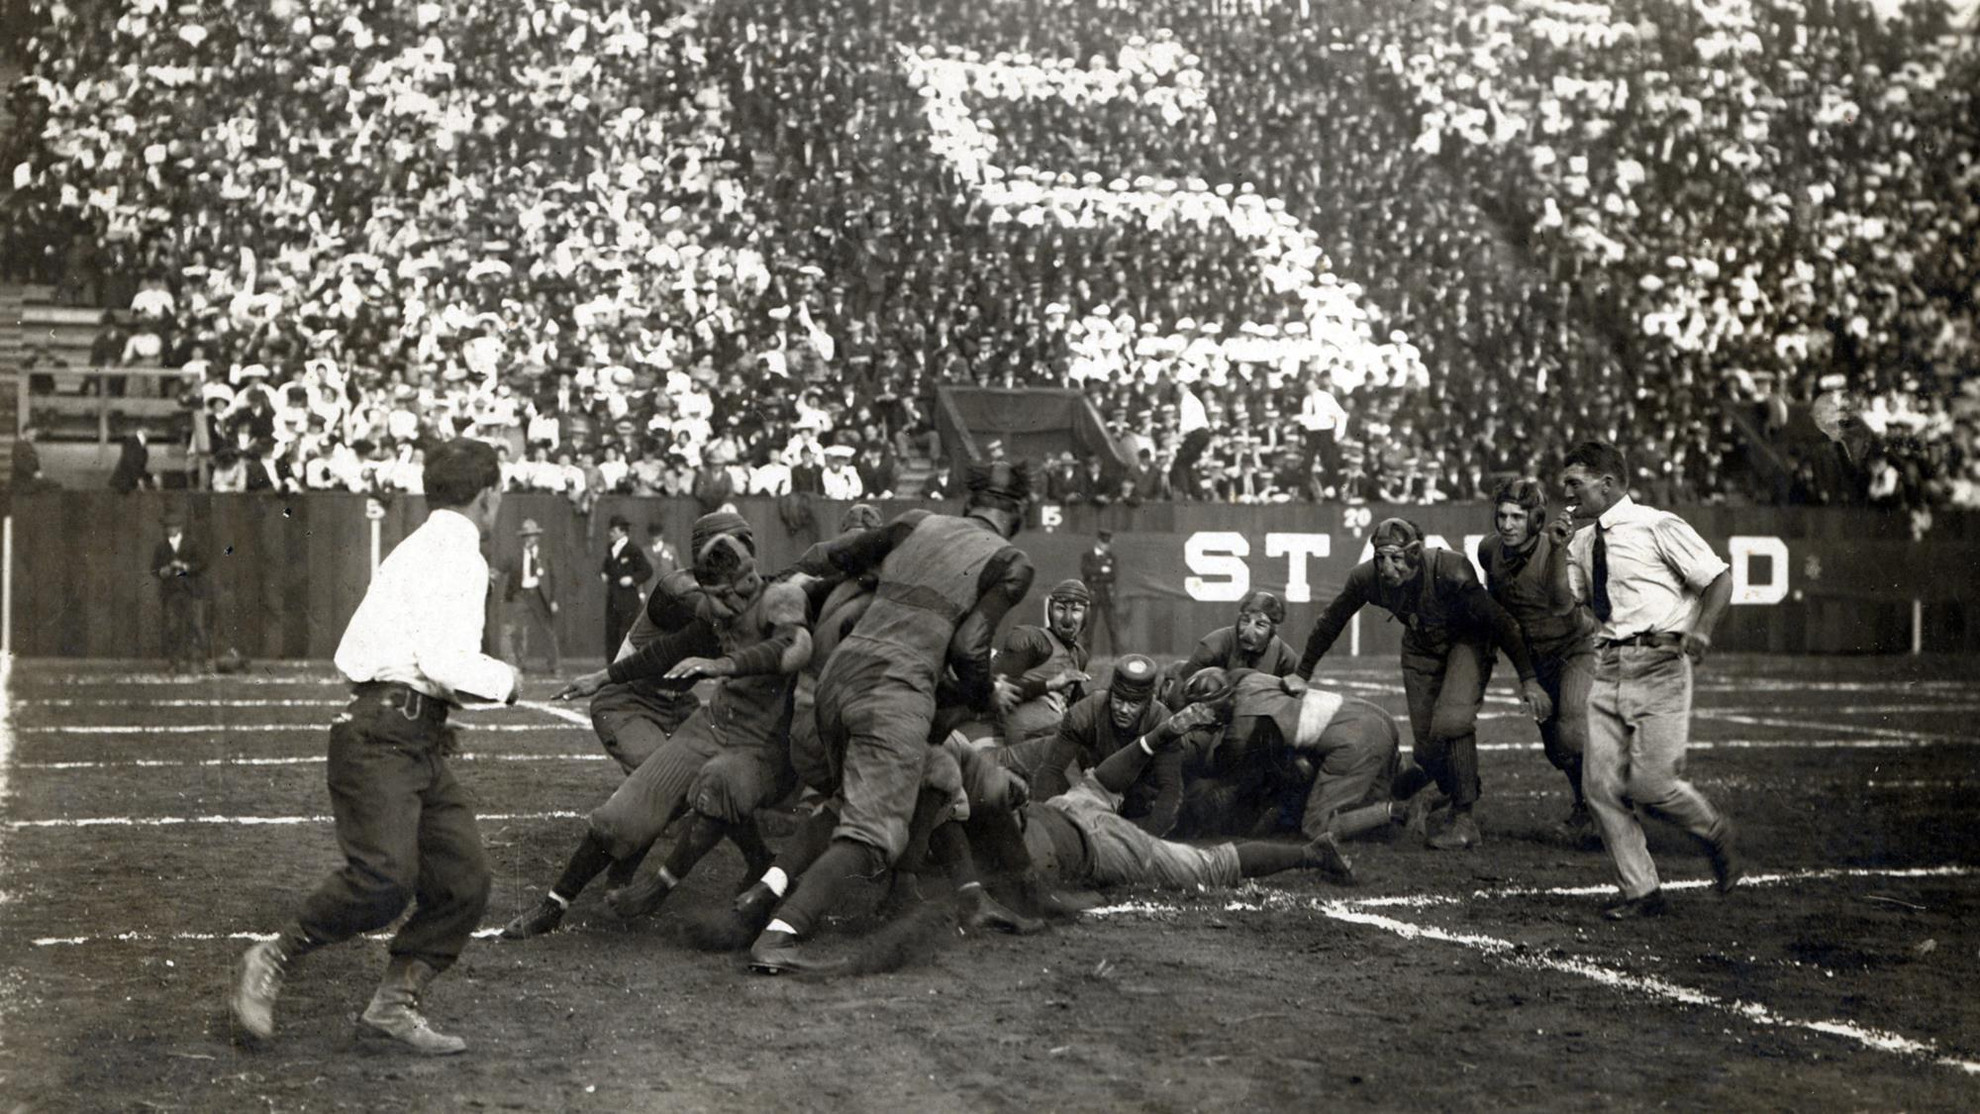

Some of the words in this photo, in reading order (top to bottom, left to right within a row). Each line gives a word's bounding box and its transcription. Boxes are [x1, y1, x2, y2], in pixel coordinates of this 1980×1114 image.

[365, 498, 386, 519] 5
[1041, 505, 1063, 526] 15
[1343, 507, 1372, 528] 20
